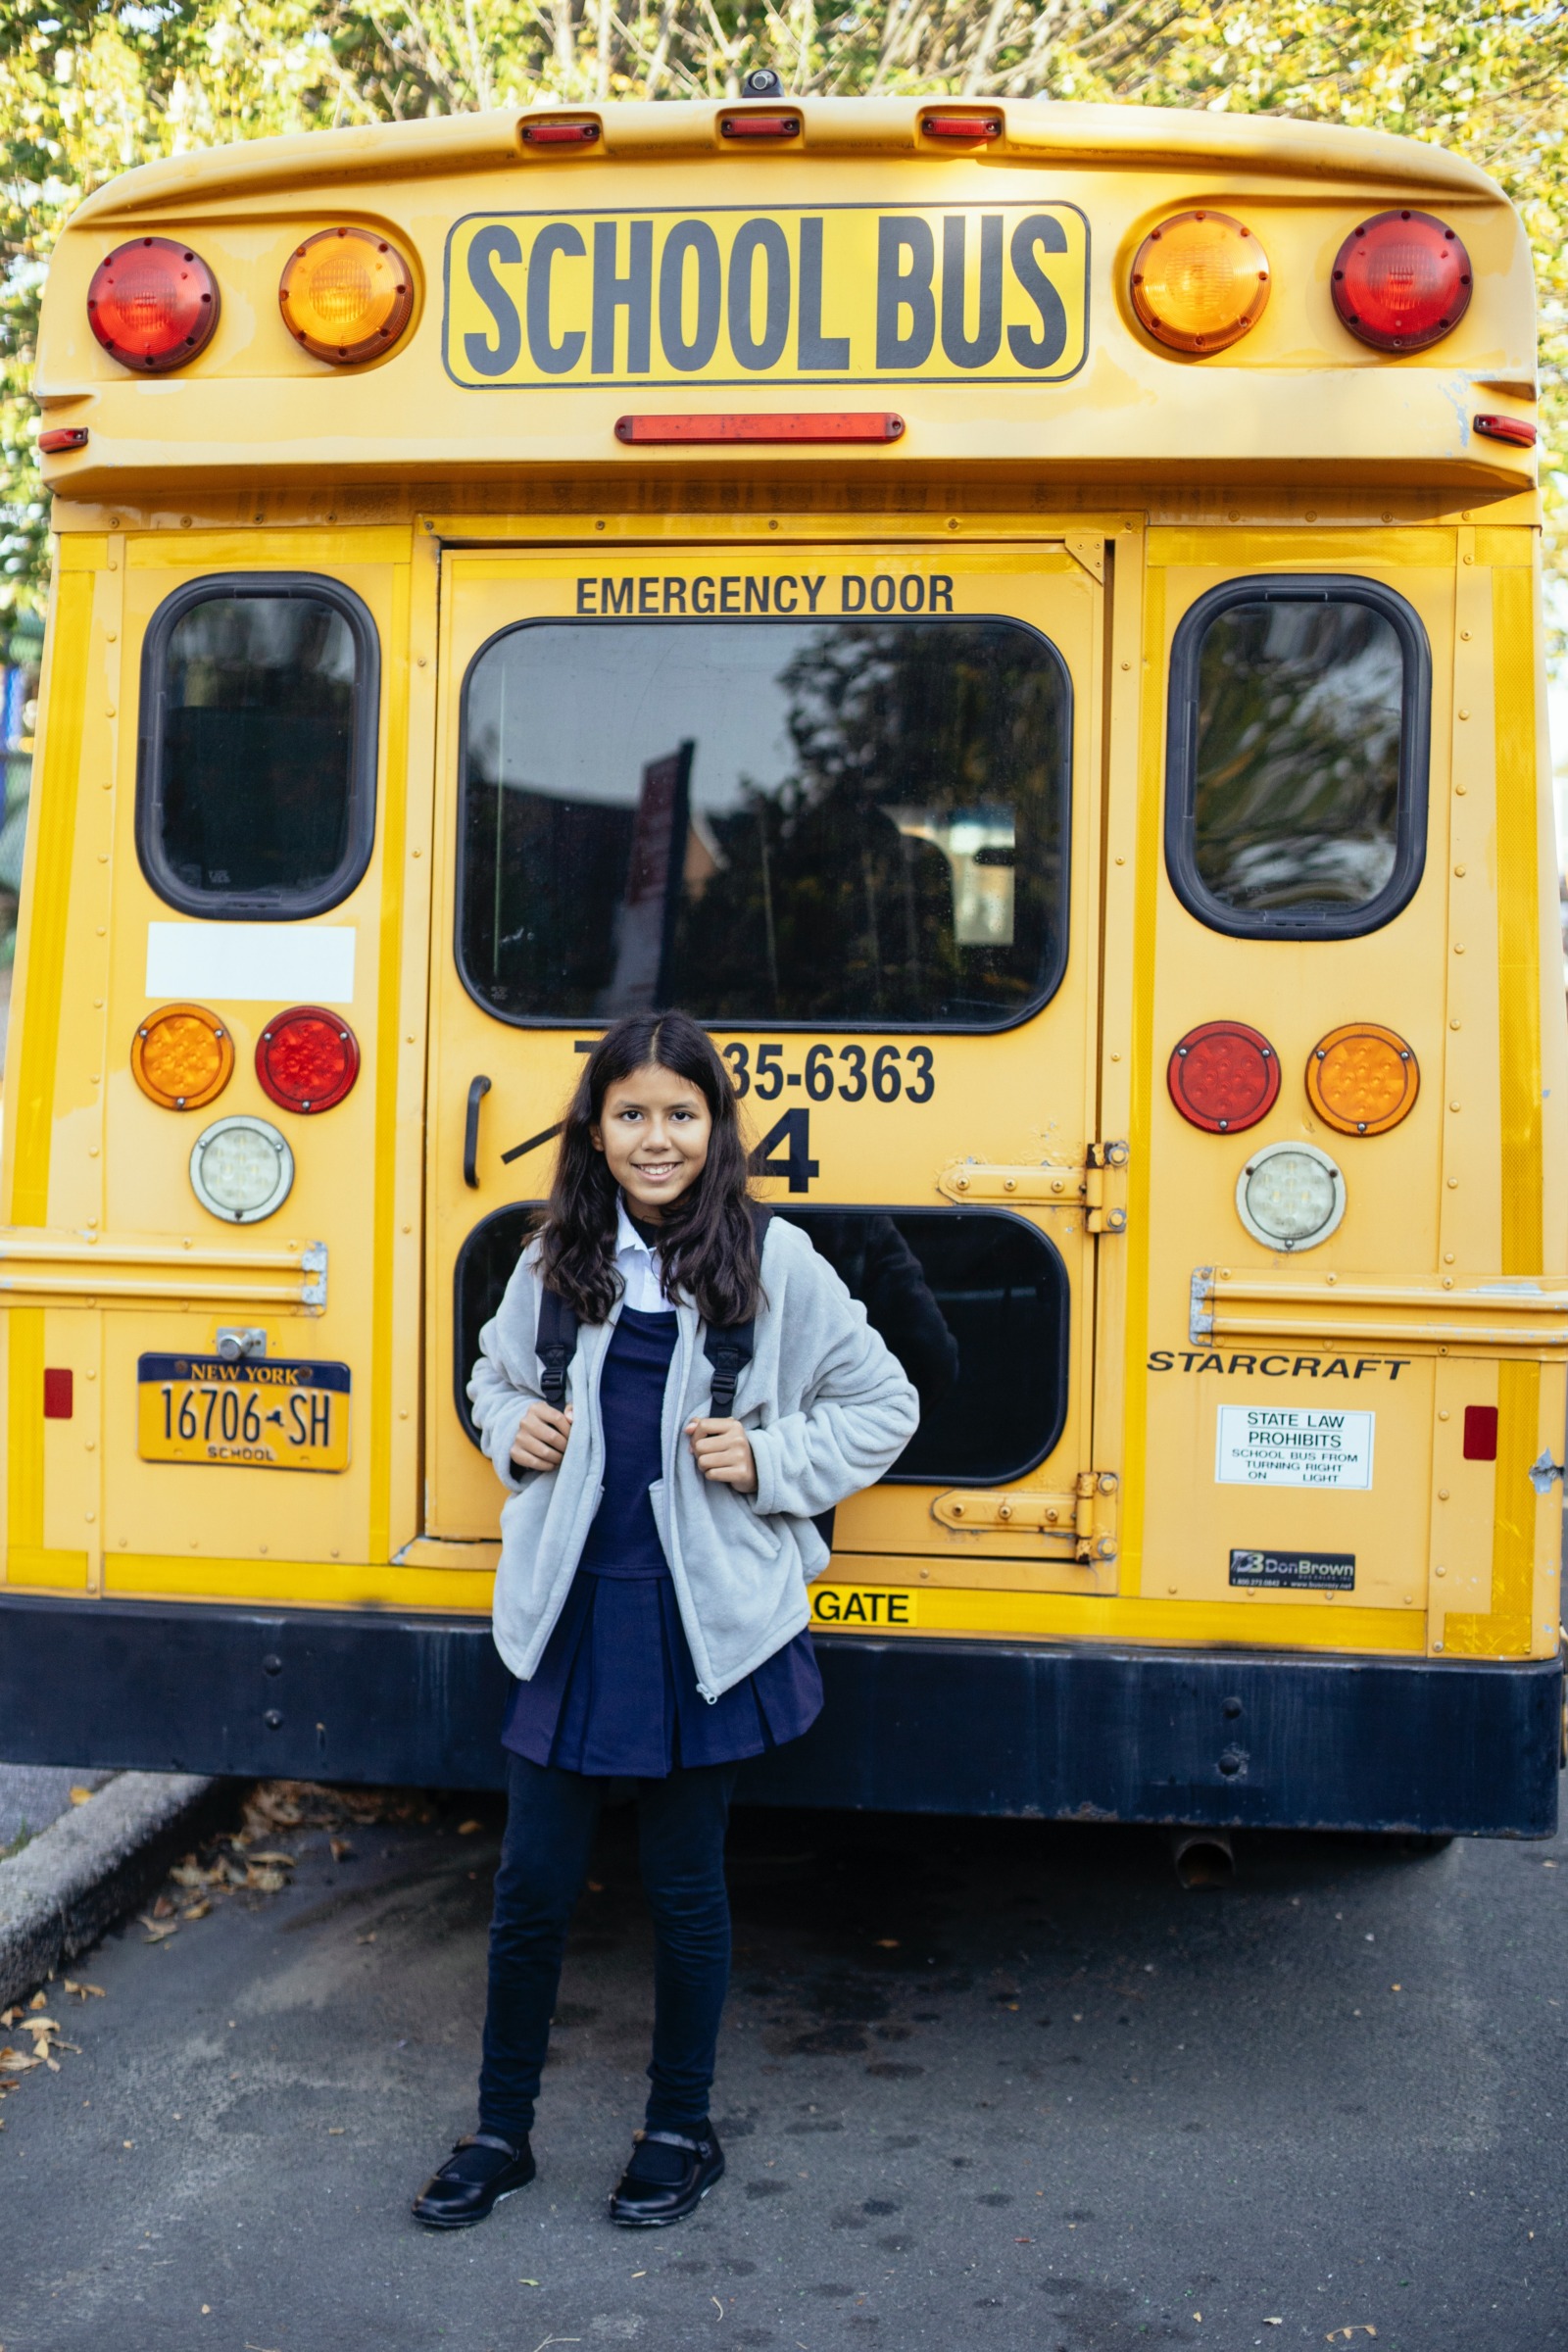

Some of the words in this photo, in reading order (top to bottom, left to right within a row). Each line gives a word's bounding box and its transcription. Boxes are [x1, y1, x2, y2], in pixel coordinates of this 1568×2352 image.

[464, 218, 851, 376] SCHOOL
[875, 214, 1068, 370] BUS
[575, 575, 826, 614] EMERGENCY
[840, 573, 955, 612] DOOR
[748, 1107, 819, 1194] 4
[191, 1363, 240, 1381] NEW
[244, 1367, 299, 1385] YORK
[1147, 1350, 1411, 1381] STARCRAFT
[162, 1387, 261, 1444] 16706
[288, 1393, 329, 1447] SH
[1247, 1411, 1299, 1427] STATE
[1307, 1414, 1346, 1429] LAW
[1249, 1431, 1343, 1448] PROHIBITS
[207, 1445, 275, 1461] SCHOOL
[1232, 1448, 1285, 1459] SCHOOL
[1290, 1451, 1316, 1461] BUS
[1321, 1453, 1358, 1462] FROM
[1247, 1460, 1300, 1471] TURNING
[1305, 1463, 1344, 1472] RIGHT
[1249, 1471, 1267, 1480] ON
[1302, 1474, 1340, 1483] LIGHT
[1265, 1559, 1354, 1576] DonBrown
[810, 1590, 909, 1624] GATE
